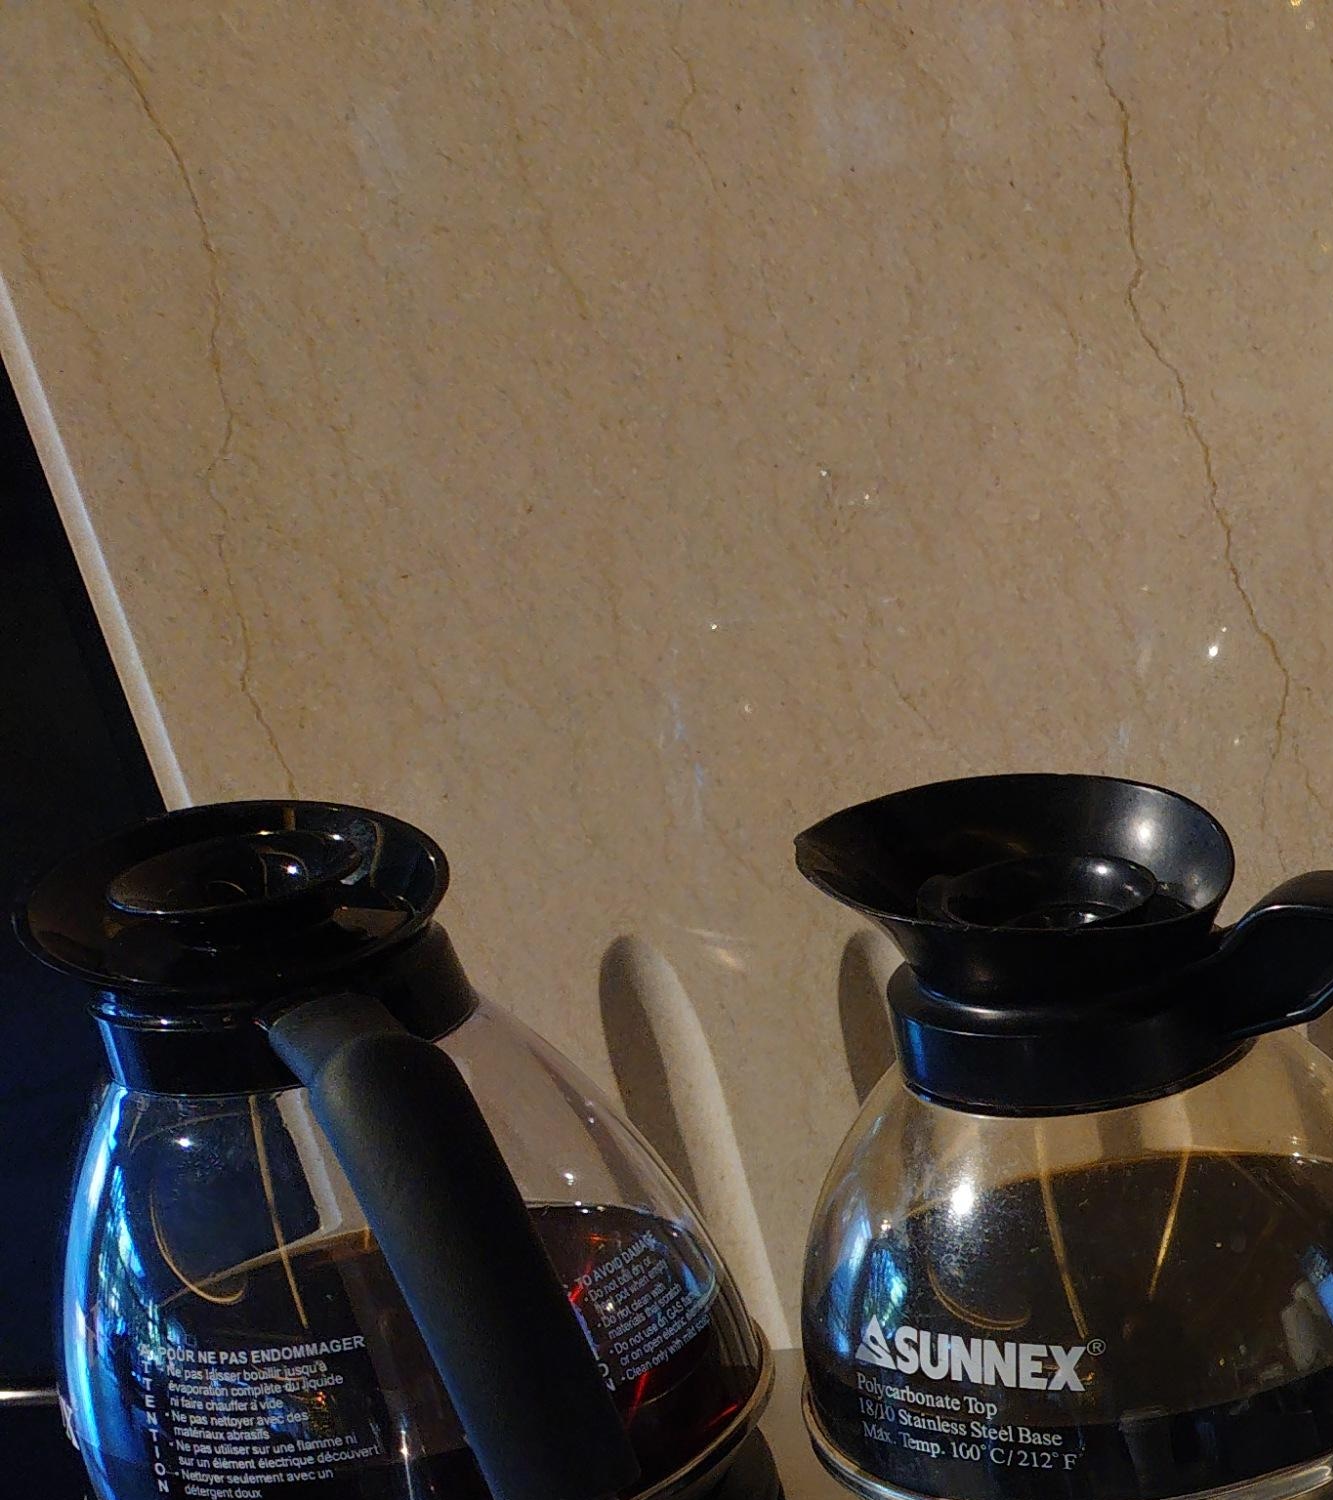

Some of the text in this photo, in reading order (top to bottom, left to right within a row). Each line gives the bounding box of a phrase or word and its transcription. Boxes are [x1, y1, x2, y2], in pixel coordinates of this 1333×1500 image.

[593, 1256, 623, 1282] AVOID
[613, 1341, 629, 1355] Do
[628, 1331, 644, 1347] not
[666, 1300, 684, 1320] GAS
[197, 1350, 217, 1364] NE
[219, 1351, 248, 1365] PAS
[251, 1335, 366, 1364] ENDOMMAGER
[894, 1325, 1087, 1392] SUNNEX
[184, 1369, 203, 1381] pas
[626, 1361, 653, 1380] Clean
[302, 1374, 344, 1393] liquide
[180, 1396, 204, 1410] faire
[205, 1398, 248, 1412] chauffer
[260, 1397, 284, 1410] vide
[857, 1372, 998, 1420] Polycarbonate Top
[171, 1409, 187, 1423] Ne
[189, 1414, 208, 1426] pas
[256, 1415, 285, 1426] avec
[286, 1411, 309, 1423] des
[859, 1397, 1063, 1447] 18/10 Stainless Steel Base
[175, 1439, 191, 1452] Ne
[193, 1443, 213, 1455] pas
[214, 1443, 250, 1455] utiliser
[252, 1445, 271, 1455] sur
[273, 1443, 296, 1454] une
[296, 1436, 344, 1451] flamme
[316, 1444, 381, 1463] découvert
[899, 1431, 946, 1459] Temp.
[181, 1469, 334, 1485] Nettoyer seulement avec un
[184, 1484, 263, 1500] détergent doux
